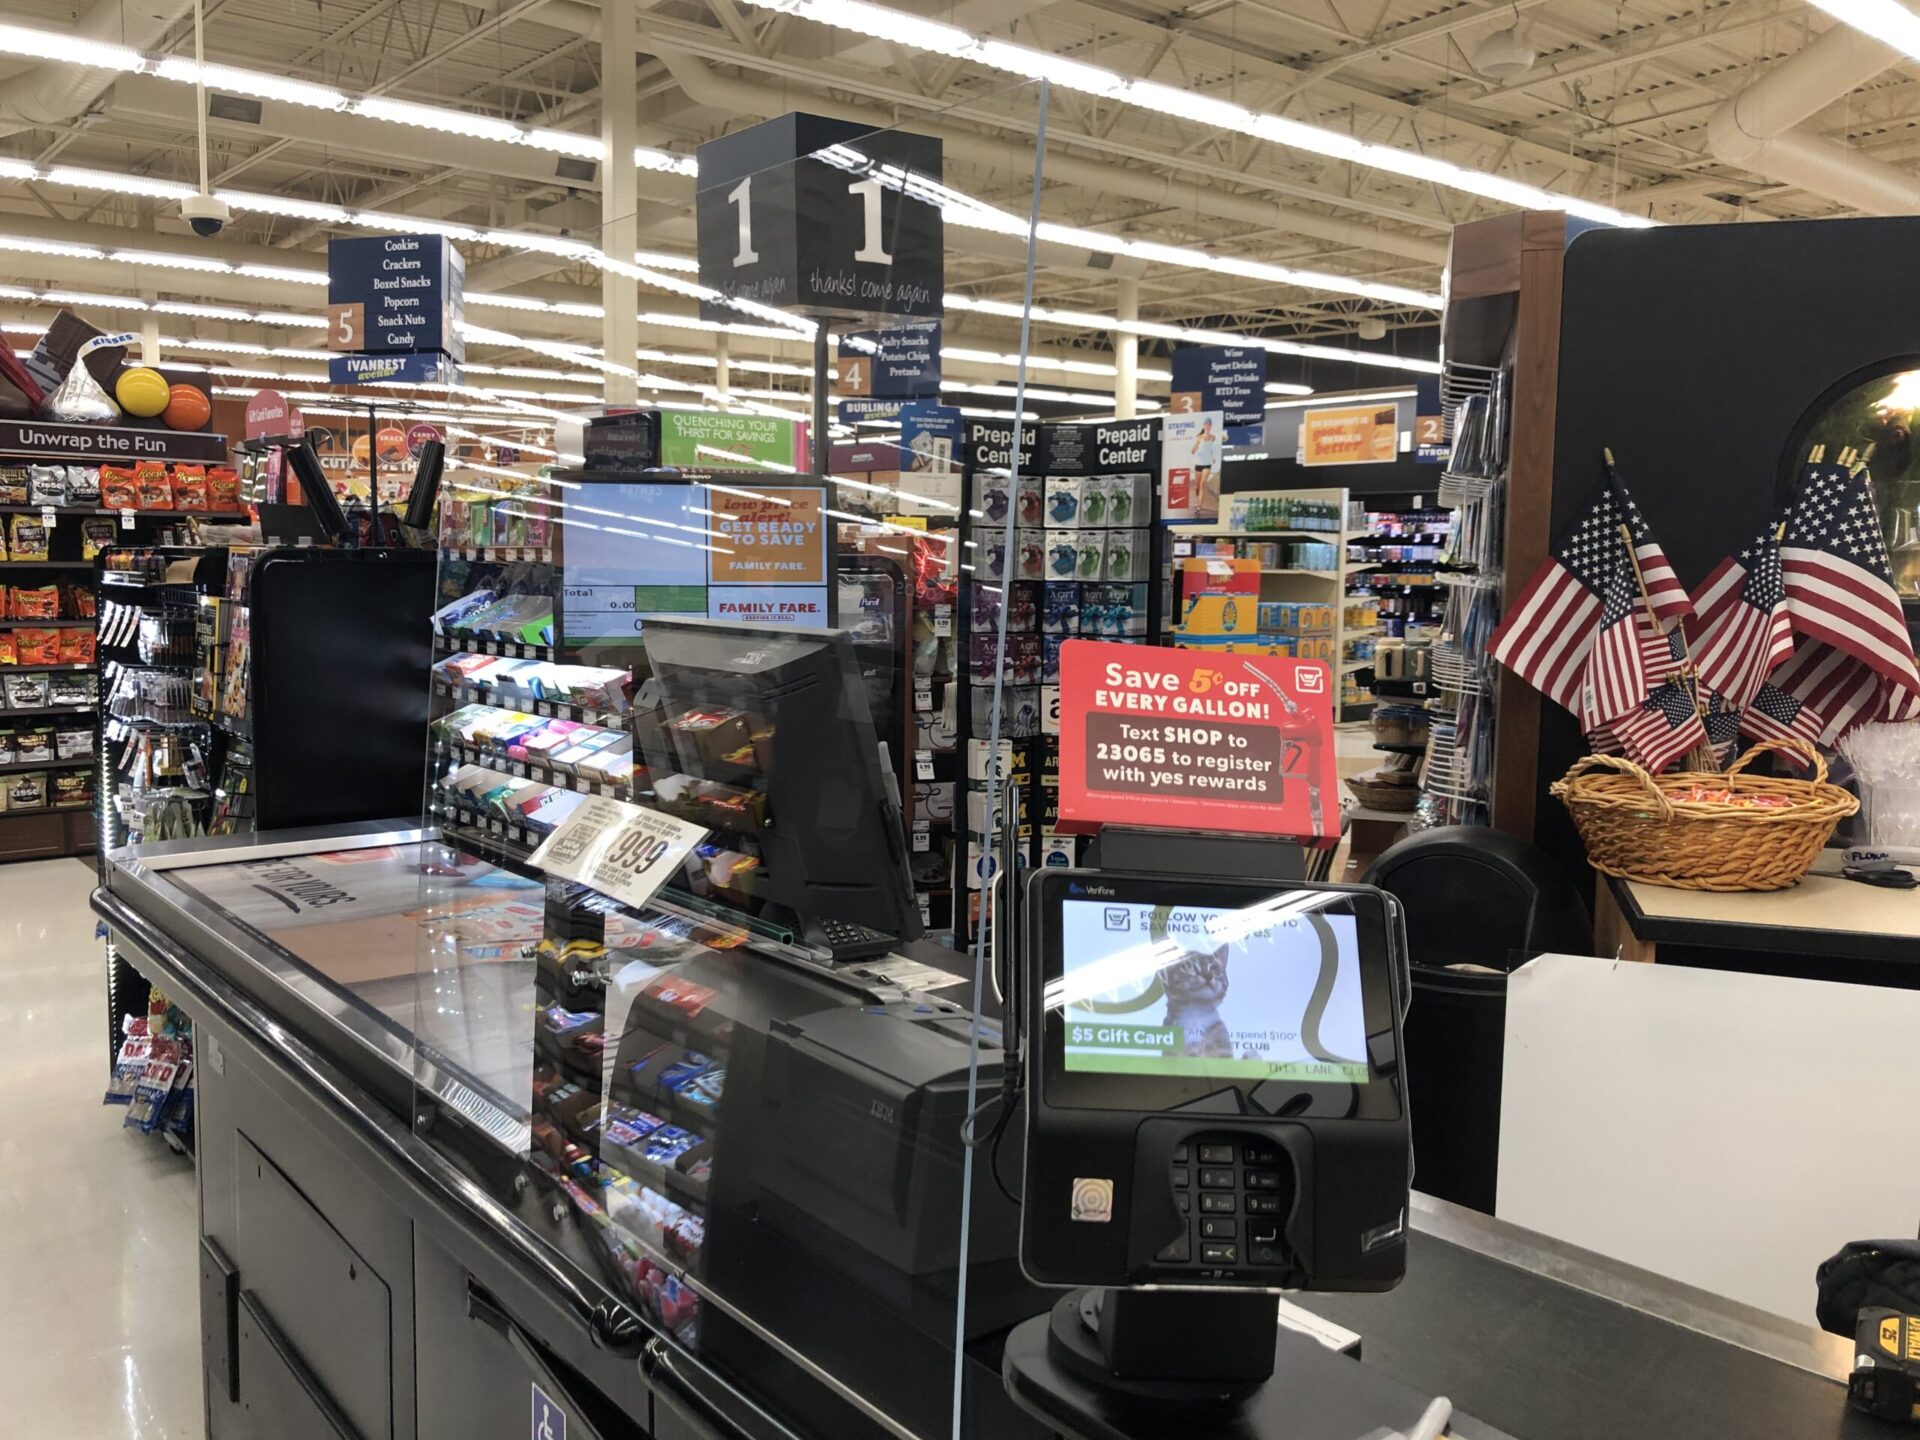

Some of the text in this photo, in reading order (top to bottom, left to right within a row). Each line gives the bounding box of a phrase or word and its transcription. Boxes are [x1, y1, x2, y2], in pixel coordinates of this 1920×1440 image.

[728, 177, 759, 268] 1
[848, 179, 893, 265] 1
[385, 239, 419, 251] Cookies
[383, 258, 421, 270] Crackers
[373, 275, 431, 289] Boxed Snacks
[810, 267, 930, 313] thanks! come again
[384, 297, 419, 310] Popcorn
[338, 308, 353, 343] 5
[378, 314, 425, 326] Snack Nuts
[92, 333, 133, 346] KISSES
[387, 332, 415, 347] Candy
[882, 336, 929, 349] Salty Snacks
[881, 351, 930, 363] Potato Chips
[1224, 349, 1243, 357] Wine
[347, 359, 406, 371] IVANREST
[1211, 361, 1257, 372] Sport Drinks
[845, 363, 862, 390] 4
[890, 366, 921, 377] Pretzels
[1208, 374, 1259, 384] Energy Drinks
[847, 402, 916, 412] BURLINGA
[1181, 397, 1193, 413] 3
[673, 414, 778, 432] QUENCHING YOUR
[677, 427, 775, 443] THIRST FOR SAVINGS
[1097, 424, 1150, 447] Prepaid
[1423, 420, 1438, 440] 2
[19, 429, 167, 452] Unwrap the Fun
[1099, 448, 1147, 465] Center
[724, 499, 757, 510] low
[739, 512, 790, 522] alert!
[720, 522, 816, 533] GET READY
[732, 534, 804, 545] TO SAVE
[729, 562, 771, 570] FAMILY
[564, 589, 593, 597] Total
[719, 603, 775, 613] FAMILY
[1106, 663, 1260, 697] Save 5¢ OFF
[1095, 690, 1270, 719] EVERY GALLON!
[1120, 724, 1247, 748] Text SHOP to
[1096, 743, 1272, 772] 23065 to register
[1103, 766, 1267, 791] with yes rewards
[1140, 910, 1197, 922] FOLLOW
[1140, 922, 1200, 934] SAVINGS
[1072, 1028, 1094, 1043] $5
[1097, 1028, 1131, 1044] Gift
[1134, 1030, 1174, 1046] Card
[1236, 1031, 1268, 1041] spend
[1242, 1043, 1270, 1051] CLUB
[1305, 1064, 1335, 1076] LANE
[1250, 1175, 1256, 1184] 6
[1206, 1198, 1211, 1207] 8
[1251, 1199, 1257, 1208] 9
[1207, 1223, 1213, 1233] 0
